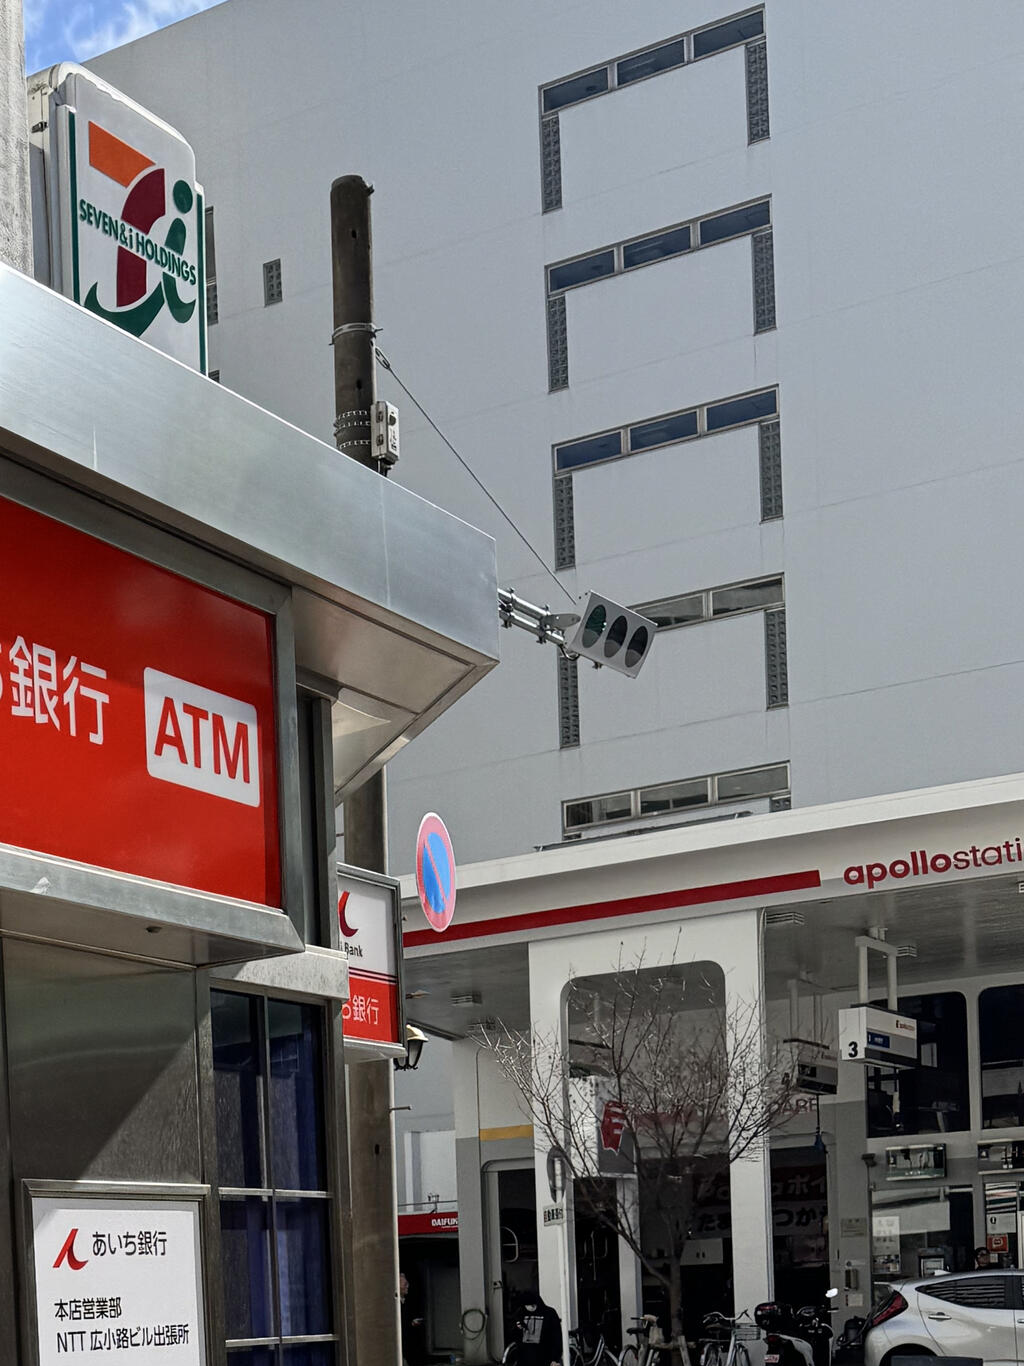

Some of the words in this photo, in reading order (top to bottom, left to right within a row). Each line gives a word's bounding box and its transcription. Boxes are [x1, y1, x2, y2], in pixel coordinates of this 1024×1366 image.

[135, 231, 197, 286] HOLDINGS
[154, 695, 251, 784] ATM
[848, 1041, 858, 1058] 3
[92, 1230, 167, 1256] あいち銀行
[54, 1296, 122, 1321] 本店営業部
[57, 1330, 86, 1353] NTT
[90, 1323, 189, 1351] 広小路ビル出張所
